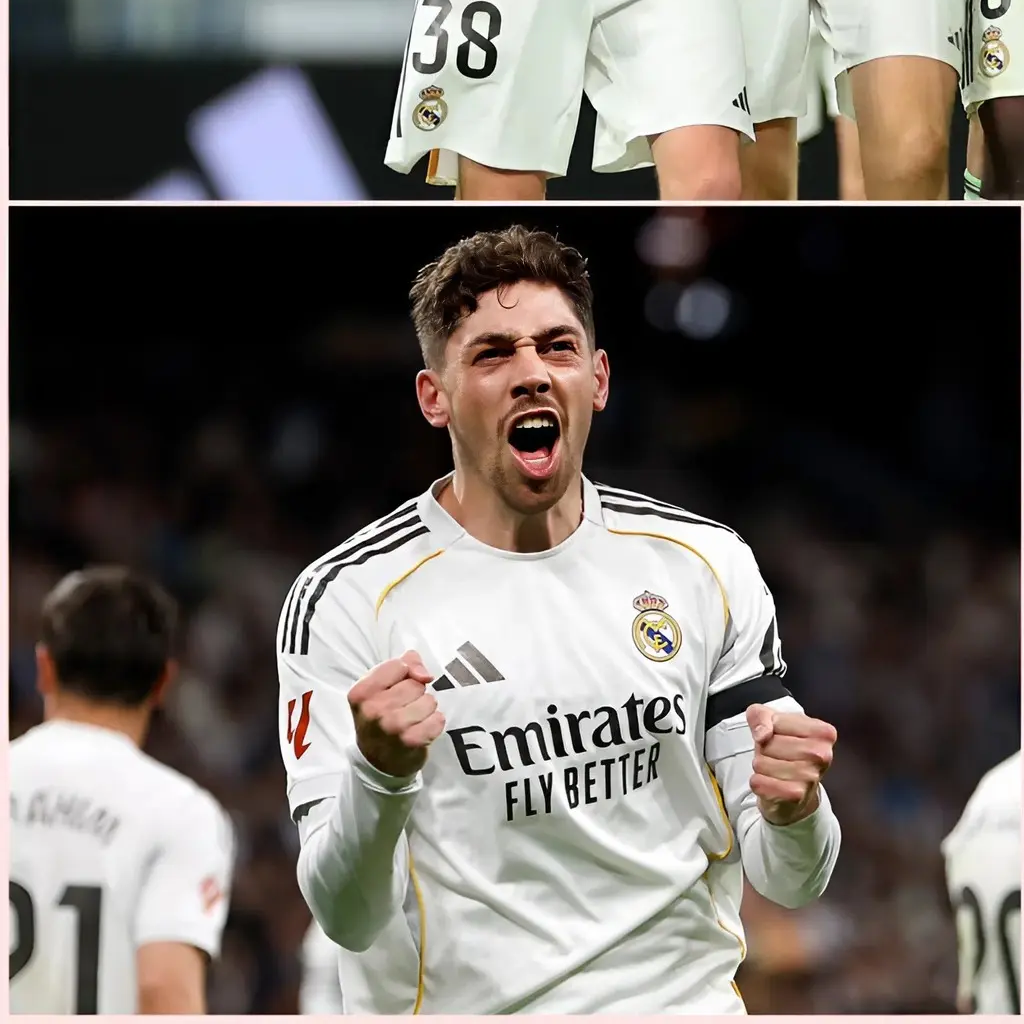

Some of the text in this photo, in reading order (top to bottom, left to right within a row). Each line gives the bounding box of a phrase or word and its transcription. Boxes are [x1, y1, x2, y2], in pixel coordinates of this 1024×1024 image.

[446, 692, 686, 776] Emirates
[505, 741, 661, 822] FLY BETTER
